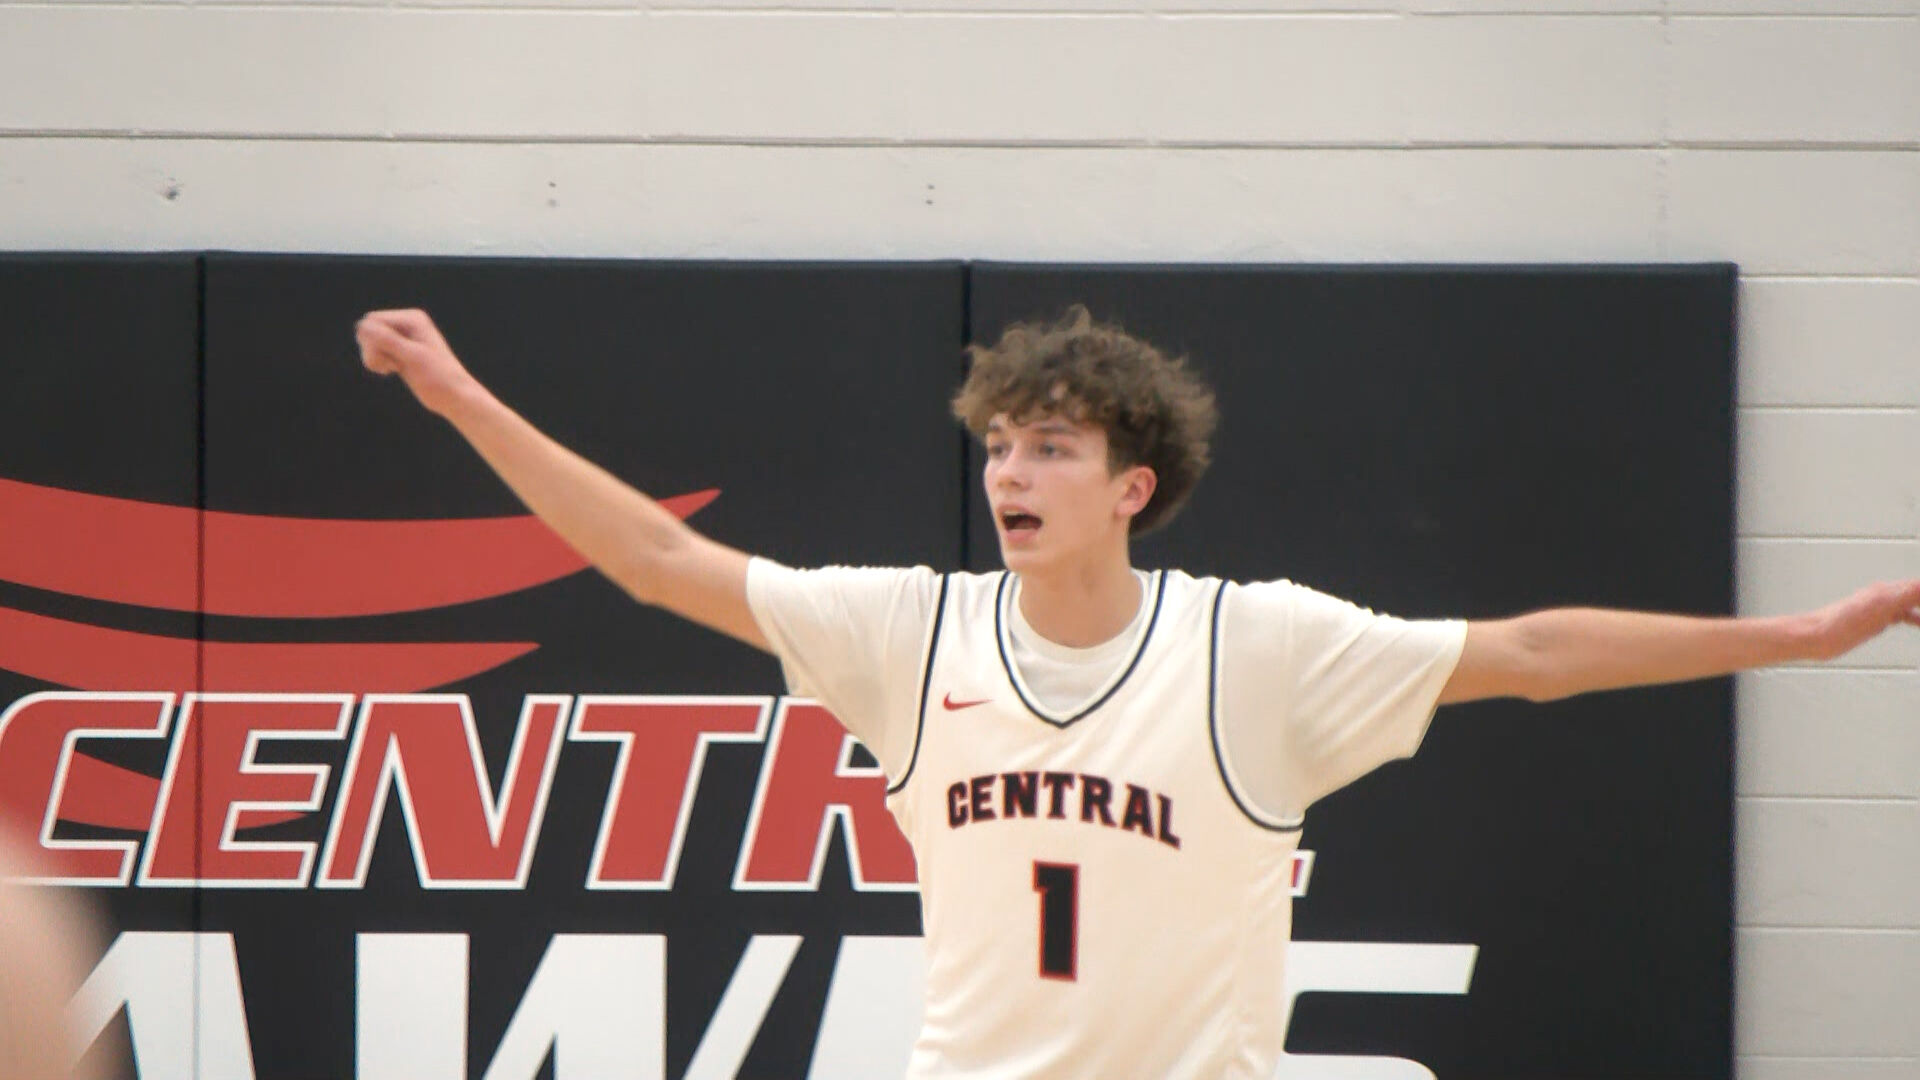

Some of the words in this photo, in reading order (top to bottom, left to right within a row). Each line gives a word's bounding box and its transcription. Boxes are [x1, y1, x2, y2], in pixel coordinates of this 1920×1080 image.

[0, 691, 1314, 897] CENTR
[947, 771, 1181, 850] CENTRAL
[1032, 860, 1080, 983] 1
